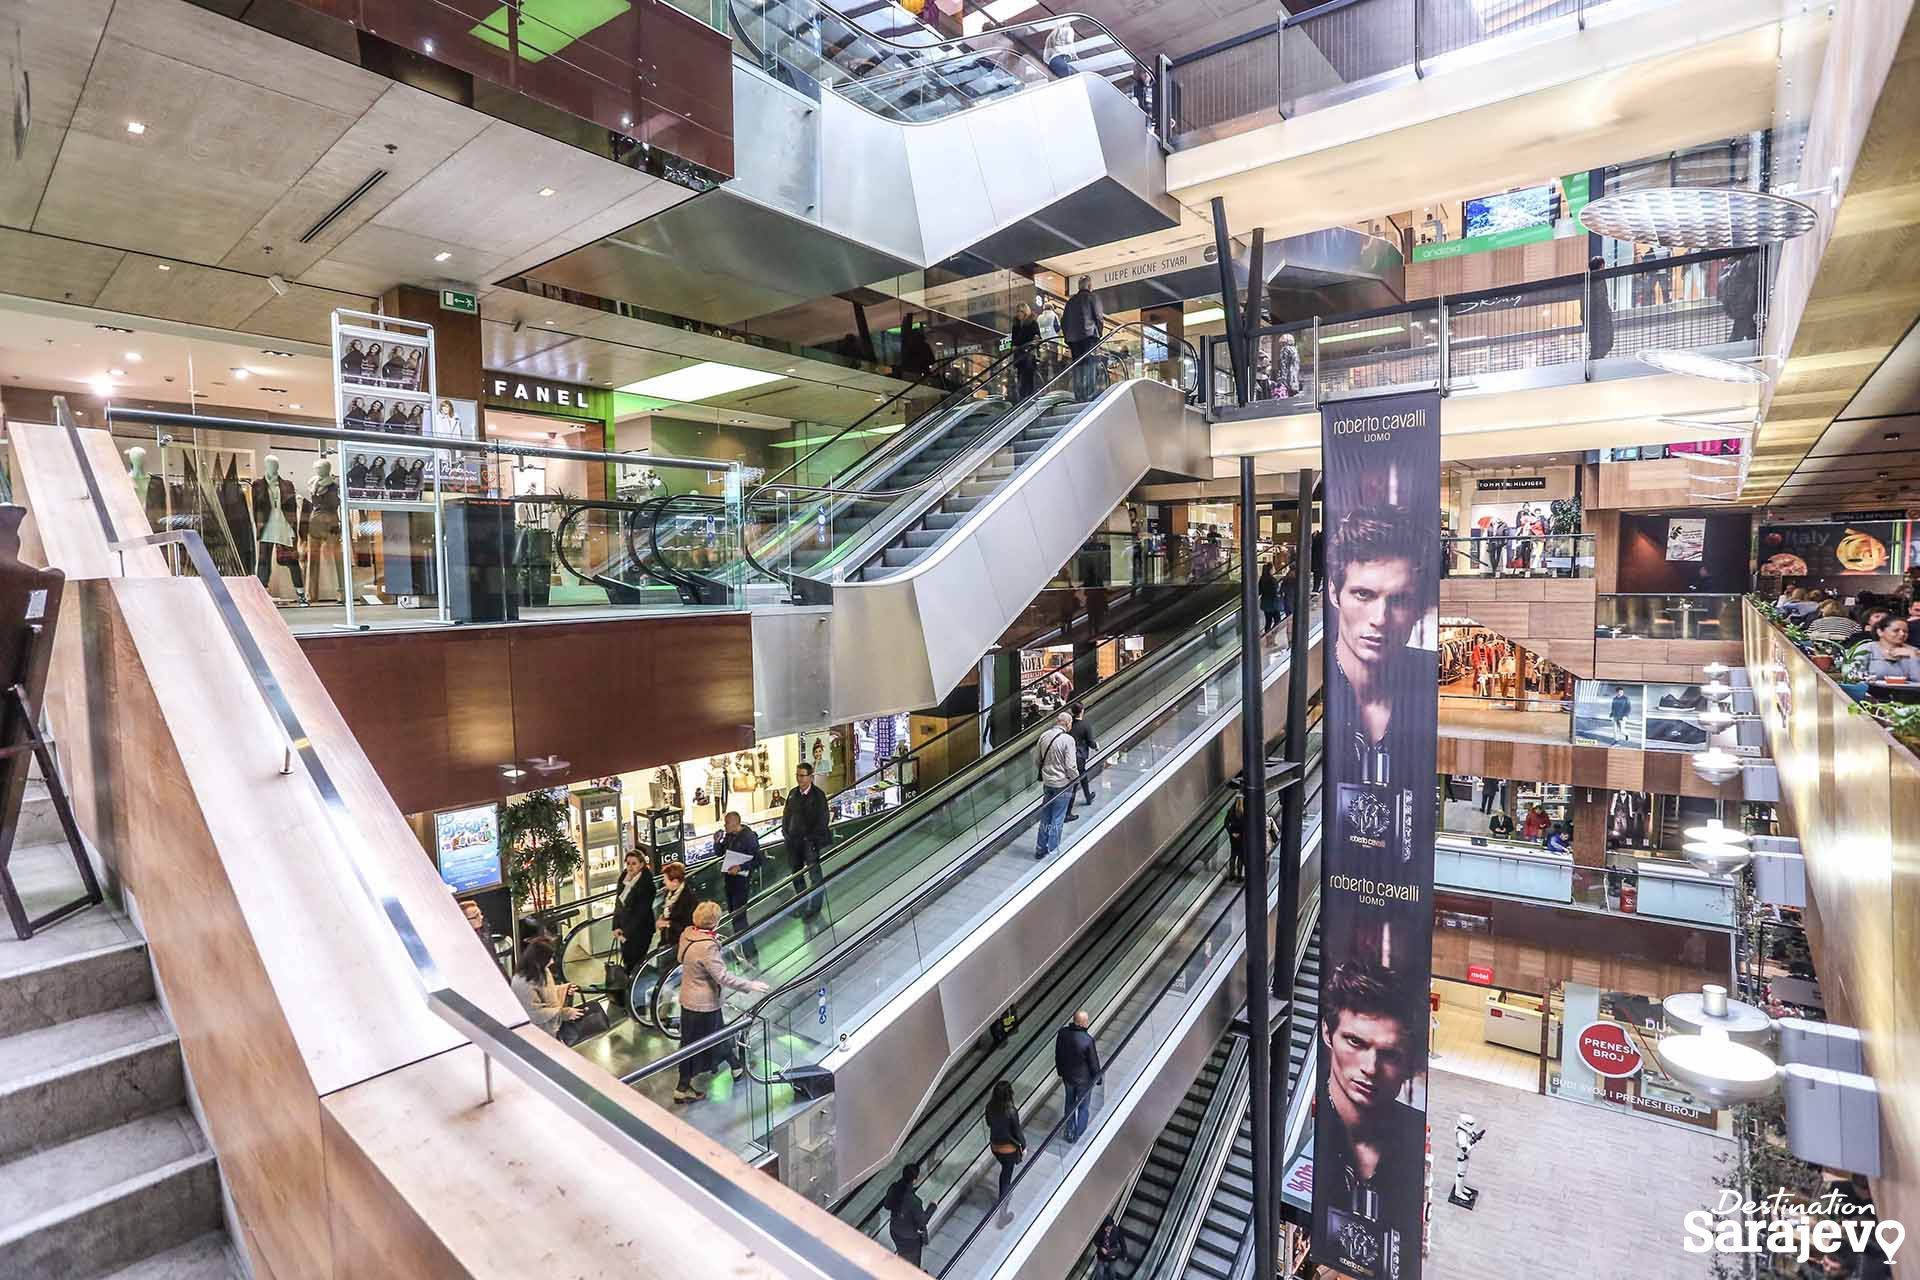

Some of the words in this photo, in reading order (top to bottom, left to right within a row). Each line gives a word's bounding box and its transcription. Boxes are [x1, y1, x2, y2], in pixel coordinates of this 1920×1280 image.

[1104, 268, 1129, 283] LIJEPE
[1161, 255, 1188, 270] STVARI
[1333, 416, 1380, 434] roberto
[1382, 409, 1426, 429] cavalli
[1363, 432, 1391, 443] UOMO
[1329, 874, 1375, 894] roberto
[1376, 882, 1420, 902] cavalli
[1359, 895, 1385, 907] UOMO
[1584, 1037, 1634, 1055] PRENESI
[1593, 1049, 1625, 1063] BROJ
[1615, 1091, 1662, 1111] PRENESI
[1665, 1102, 1699, 1119] BROJ!
